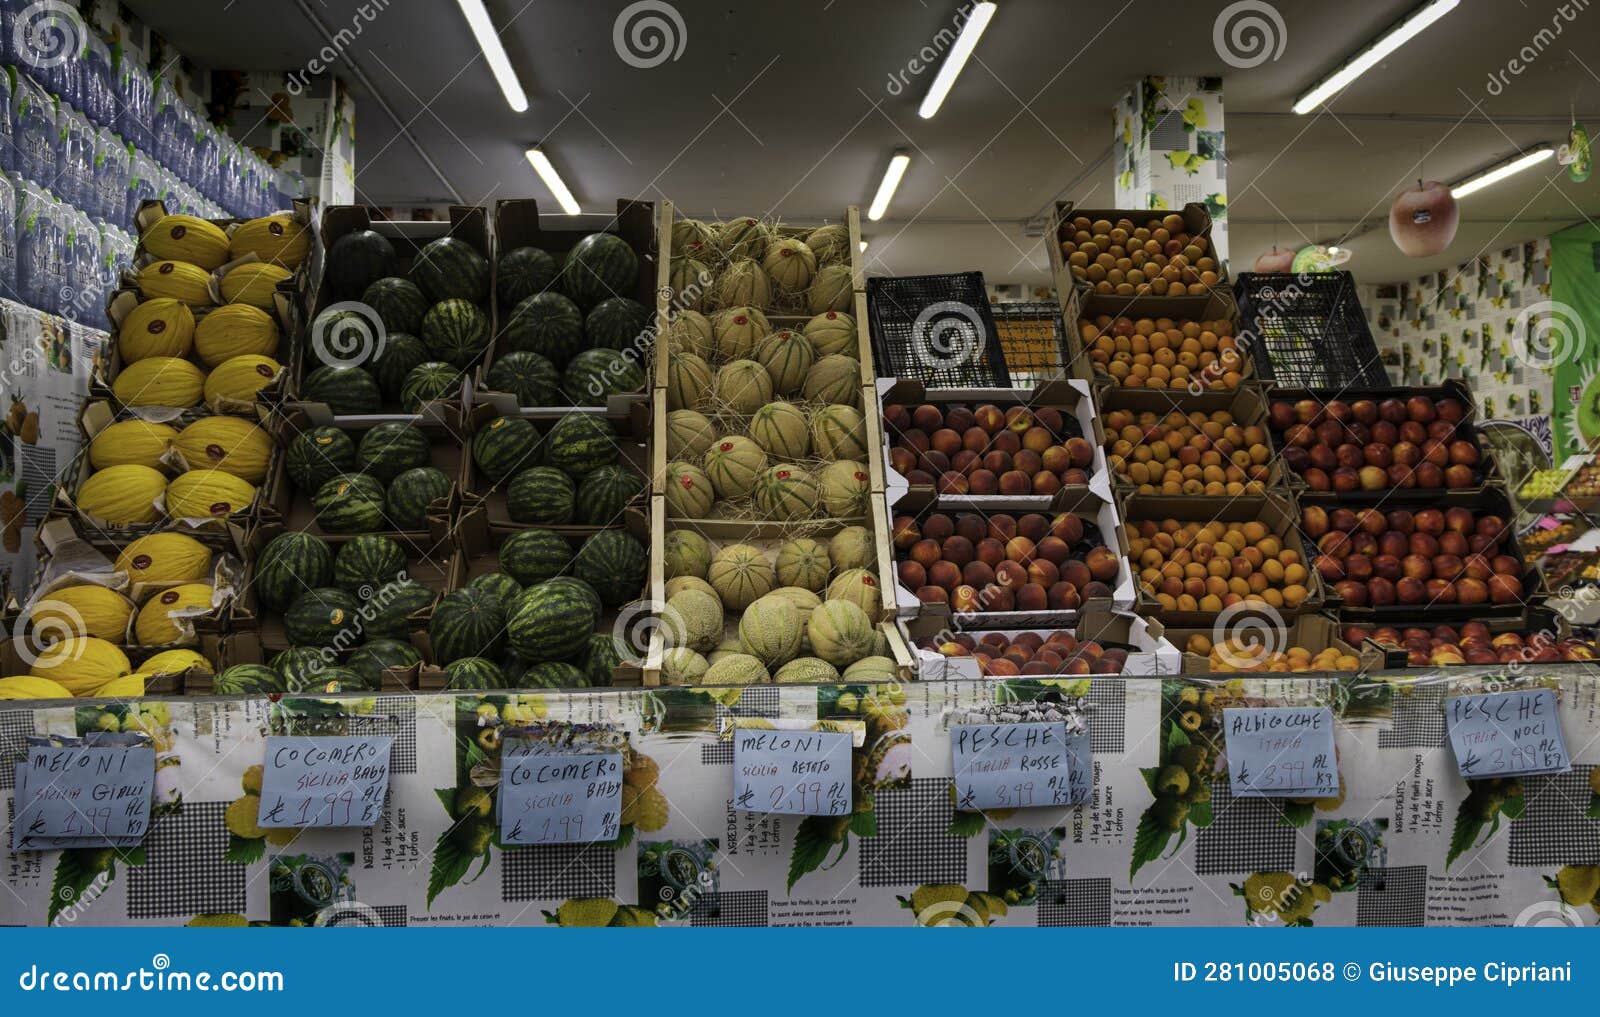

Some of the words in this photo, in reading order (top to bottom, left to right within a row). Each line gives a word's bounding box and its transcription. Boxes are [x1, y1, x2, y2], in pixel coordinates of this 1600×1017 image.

[1454, 693, 1543, 722] PESCHE
[741, 734, 823, 752] MELONI
[959, 726, 1053, 755] PESCHE
[33, 750, 129, 776] MELONI
[274, 742, 377, 769] COCOMERO
[1020, 754, 1060, 771] ROSSE
[510, 758, 617, 786] COCOMERO
[1093, 761, 1102, 786] rouges
[769, 782, 822, 813] 2,99
[826, 781, 846, 799] AL
[1091, 789, 1100, 810] fruits
[125, 797, 145, 817] AL
[293, 790, 354, 826] 1,99
[1114, 808, 1123, 831] citron
[537, 814, 584, 842] 1,99
[770, 819, 780, 842] citron
[408, 831, 418, 856] citron
